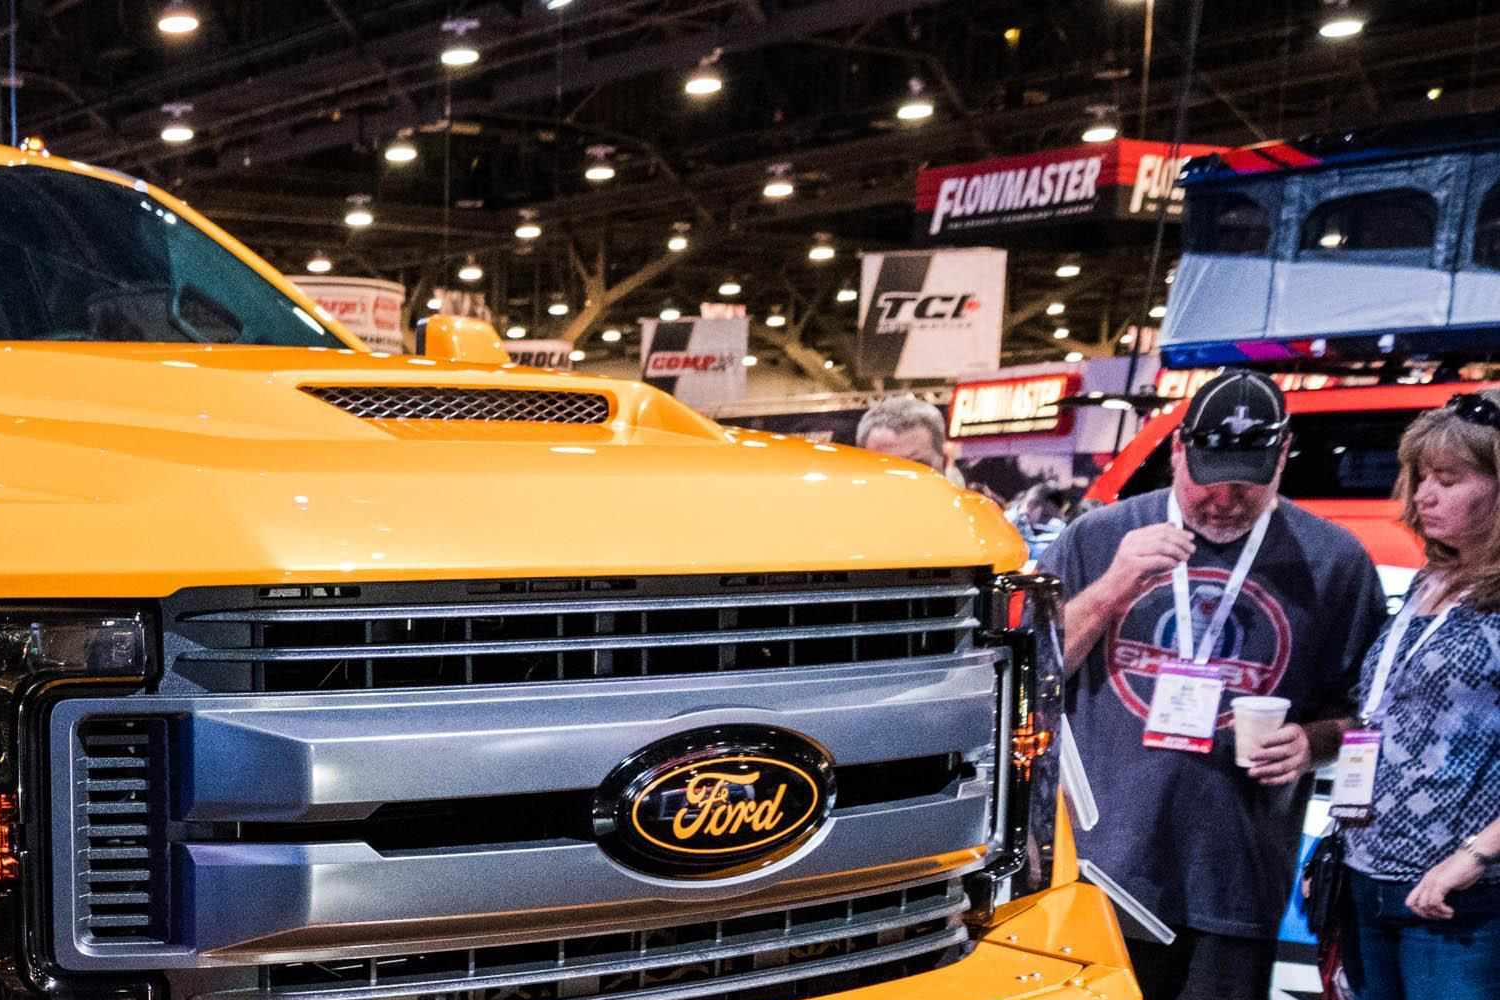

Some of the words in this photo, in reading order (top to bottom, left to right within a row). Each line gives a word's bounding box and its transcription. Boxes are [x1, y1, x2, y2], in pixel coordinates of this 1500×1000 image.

[930, 155, 1102, 236] FLOWMASTER
[883, 293, 976, 320] TCI
[1114, 646, 1271, 689] SHBY
[672, 771, 788, 840] Ford
